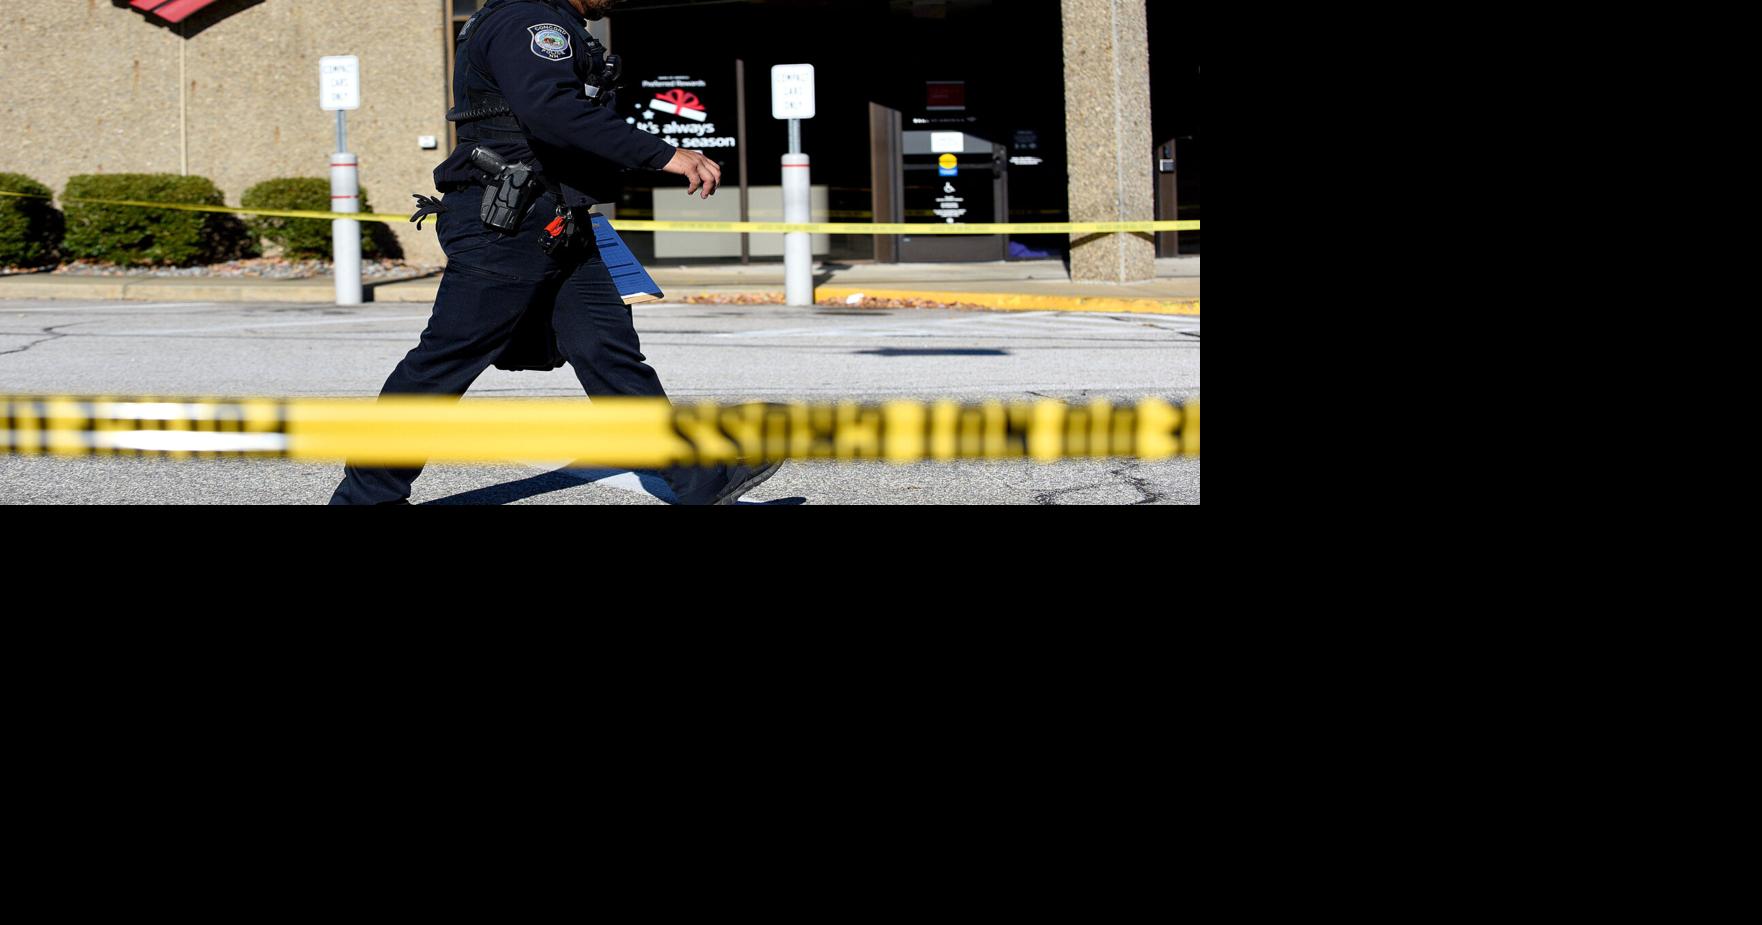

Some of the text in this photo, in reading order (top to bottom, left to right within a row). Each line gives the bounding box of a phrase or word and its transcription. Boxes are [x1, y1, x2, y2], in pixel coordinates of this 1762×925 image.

[534, 25, 567, 35] CONCORD
[662, 121, 715, 136] always
[682, 137, 735, 148] season
